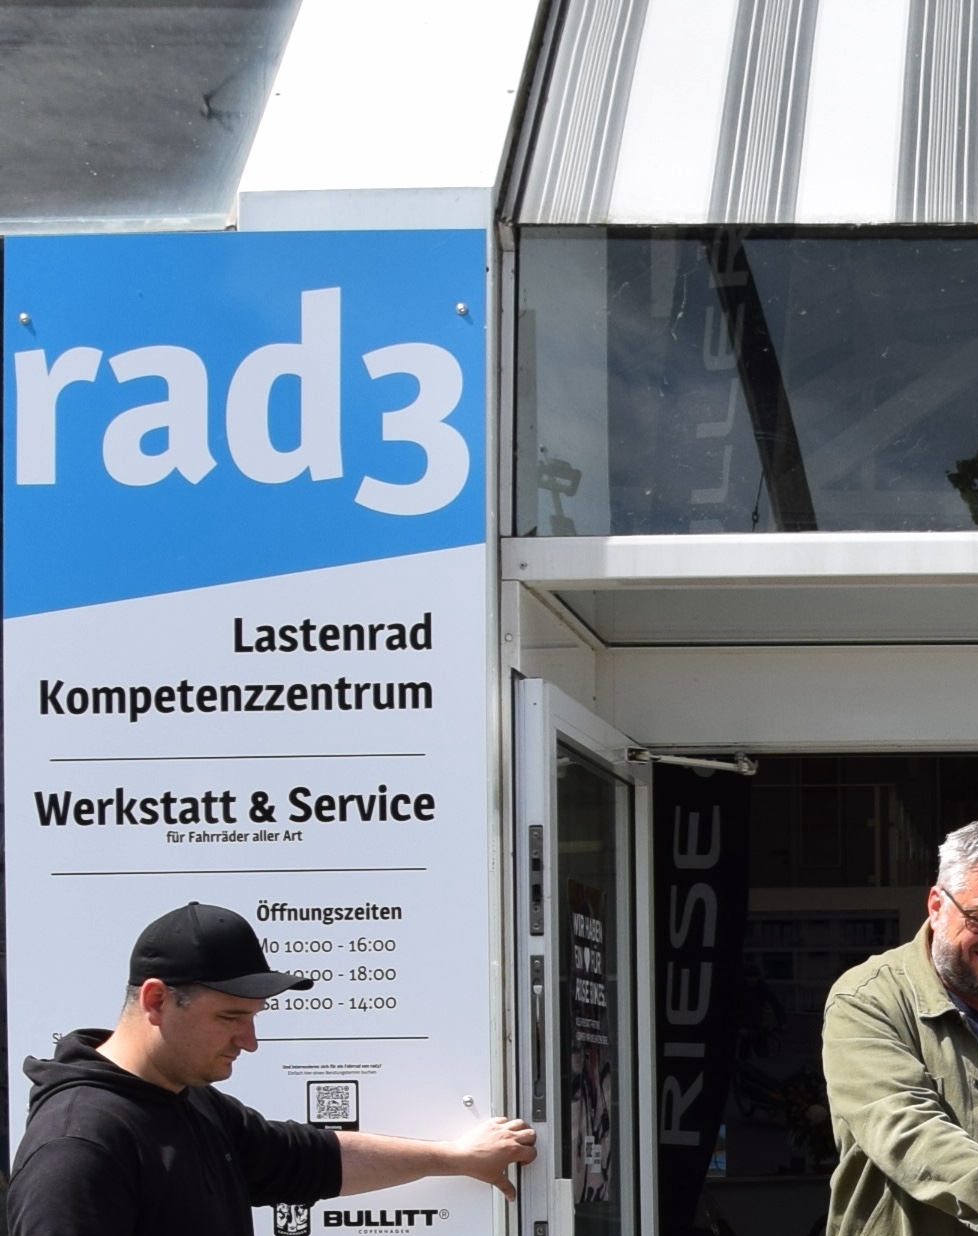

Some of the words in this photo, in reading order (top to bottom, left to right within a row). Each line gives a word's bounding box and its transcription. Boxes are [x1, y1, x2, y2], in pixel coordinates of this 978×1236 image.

[14, 286, 471, 516] rad3
[234, 612, 433, 653] Lastenrad
[40, 677, 433, 723] Kompetenzzentrum
[35, 788, 238, 827] Werkstatt
[248, 790, 277, 824] &
[288, 784, 436, 823] Service
[166, 830, 186, 843] für
[188, 830, 250, 843] Fahrräder
[252, 829, 280, 842] aller
[282, 829, 303, 842] Art
[257, 901, 402, 925] Öffnungszeiten
[284, 940, 333, 954] 10:00
[349, 937, 396, 953] 16:00
[349, 966, 397, 982] 18:00
[660, 804, 721, 1147] RIESE
[285, 997, 333, 1011] 10:00
[349, 996, 397, 1012] 14:00
